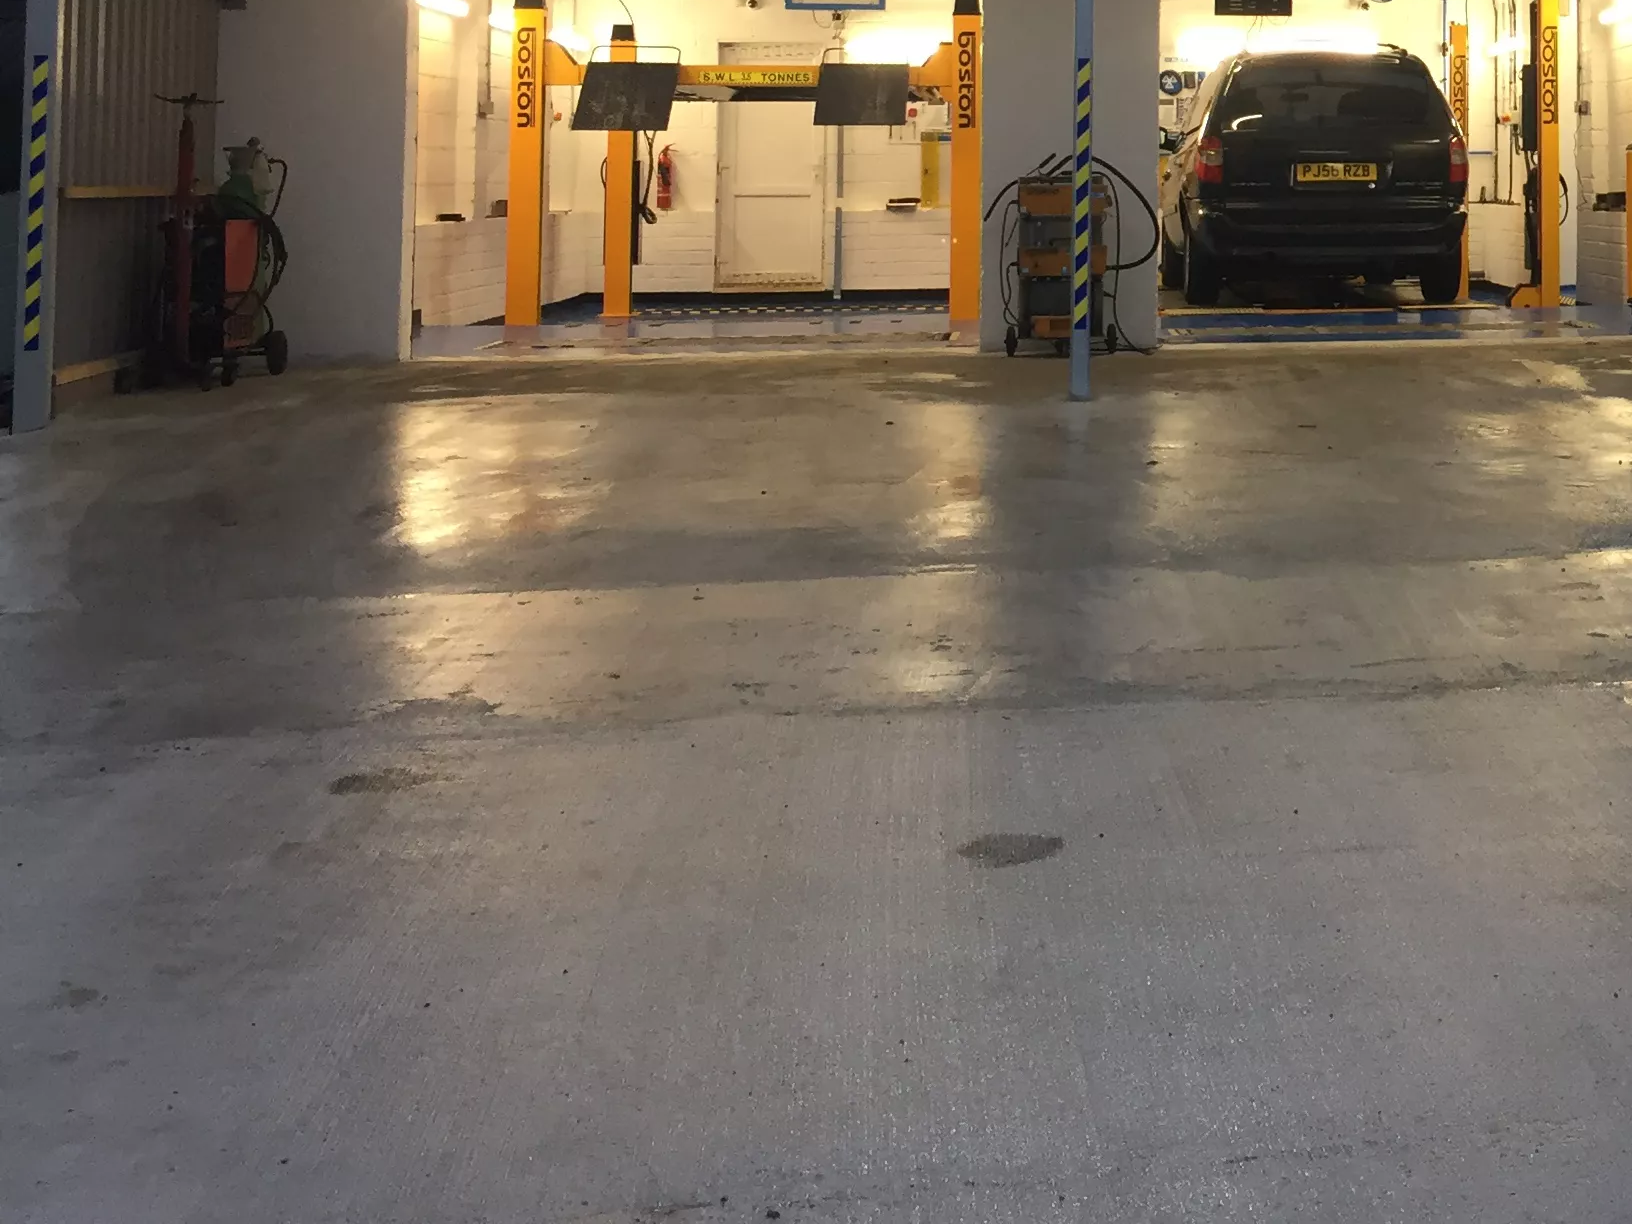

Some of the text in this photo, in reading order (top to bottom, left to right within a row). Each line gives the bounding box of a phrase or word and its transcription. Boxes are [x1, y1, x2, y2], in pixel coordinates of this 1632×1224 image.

[517, 27, 536, 128] boston
[761, 73, 810, 82] TONNES
[957, 31, 976, 128] boston
[1453, 55, 1466, 123] bosto
[1543, 25, 1558, 124] boston
[1302, 165, 1339, 178] PJ56
